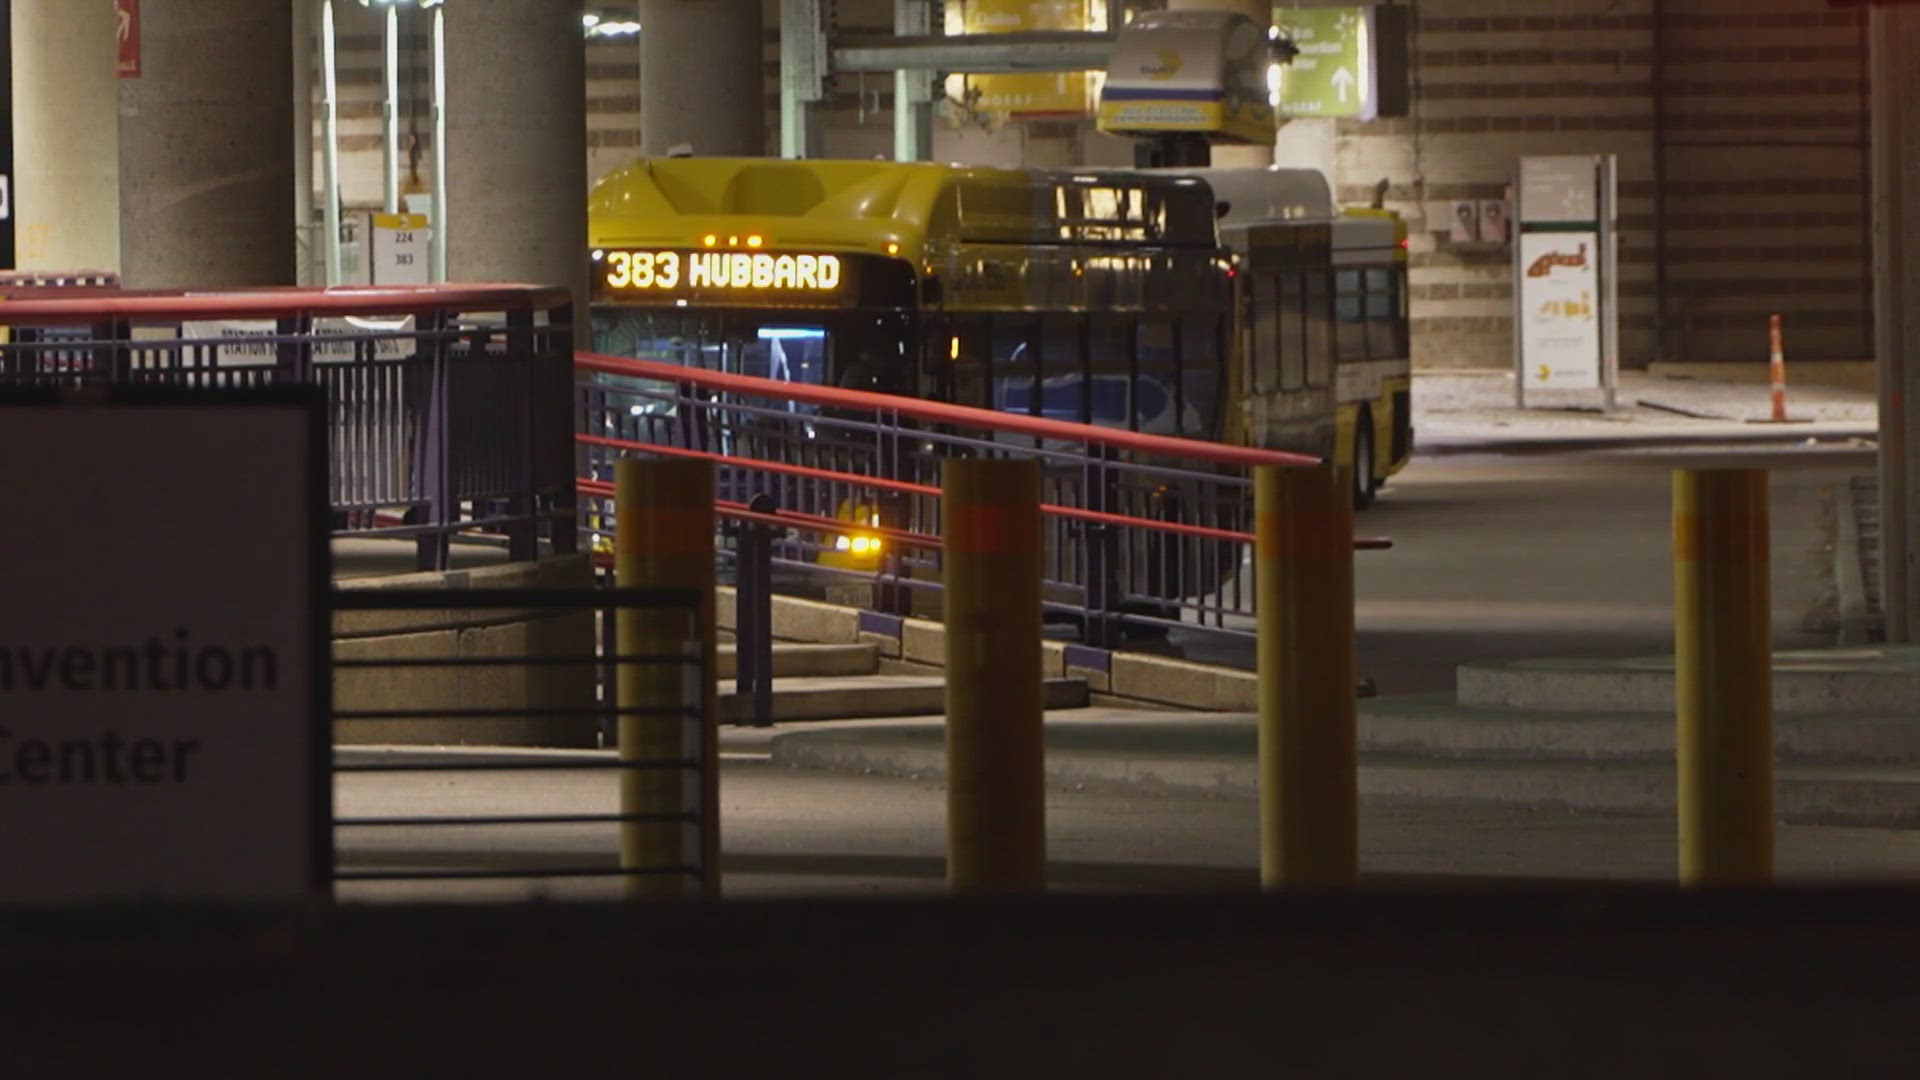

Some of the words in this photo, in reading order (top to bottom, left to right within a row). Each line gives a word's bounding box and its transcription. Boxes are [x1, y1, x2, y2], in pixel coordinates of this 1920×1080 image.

[395, 232, 413, 243] 224
[395, 253, 414, 265] 383
[606, 252, 679, 289] 383
[689, 253, 839, 290] HUBBARD
